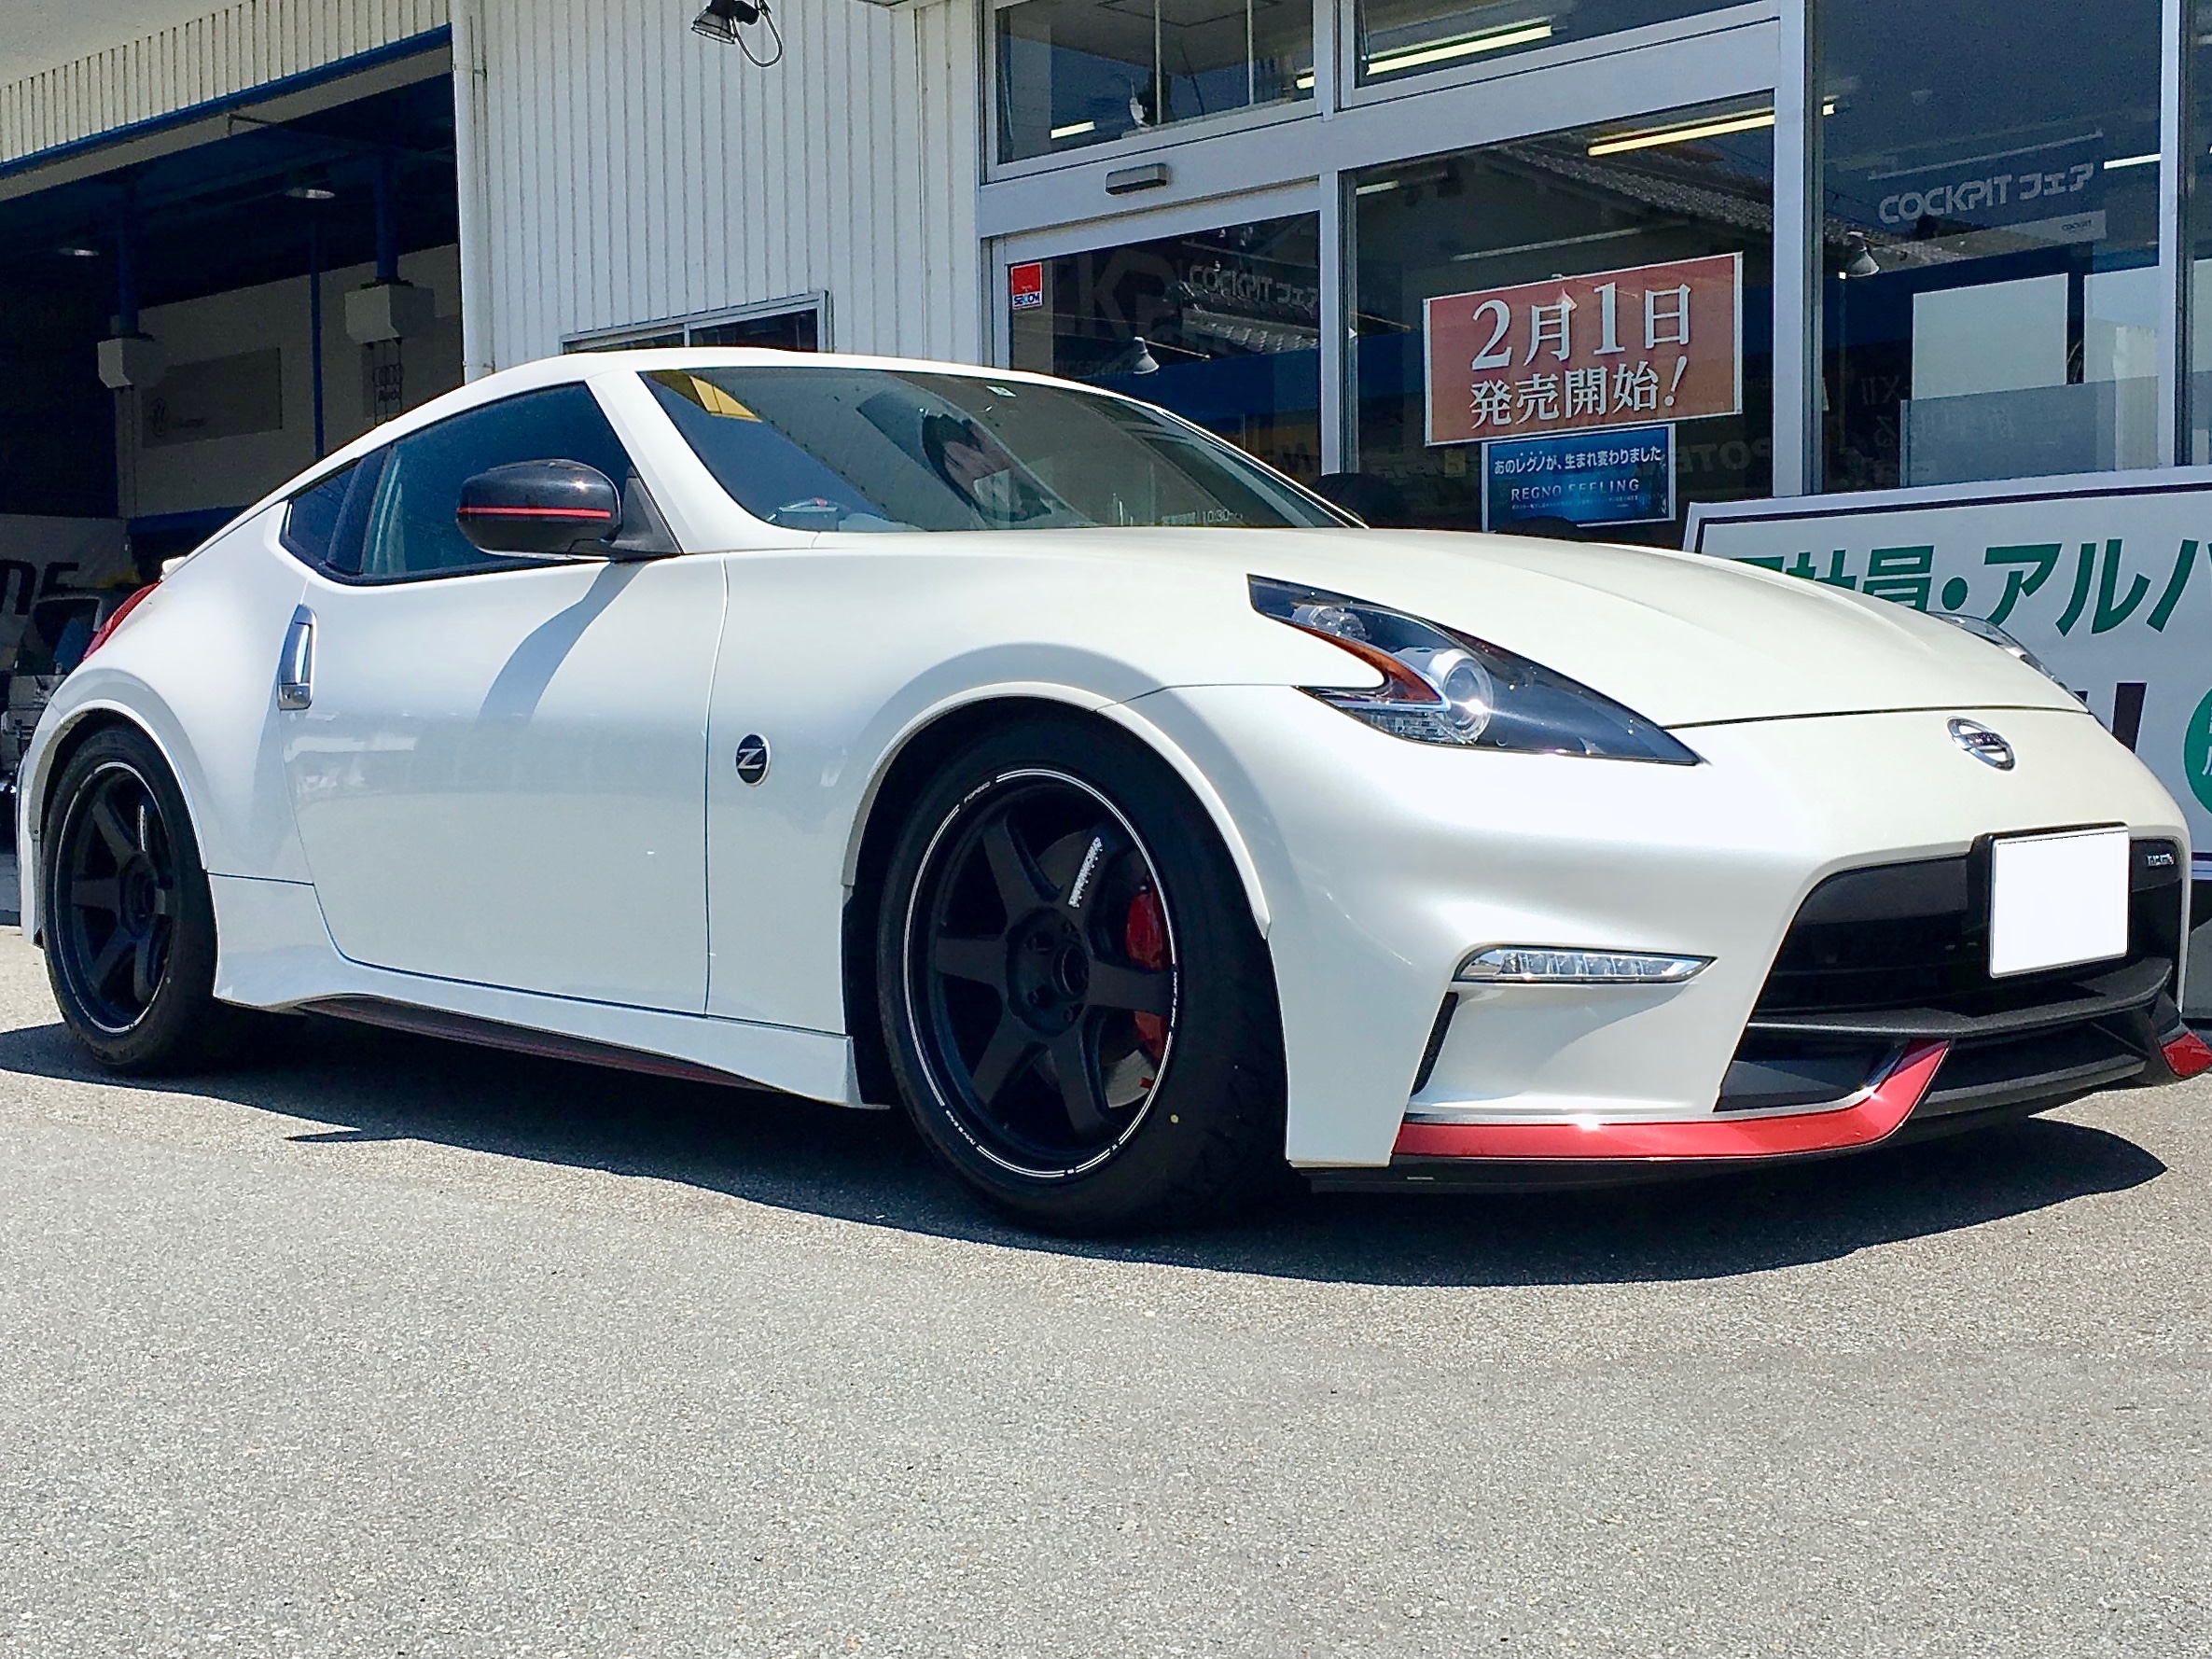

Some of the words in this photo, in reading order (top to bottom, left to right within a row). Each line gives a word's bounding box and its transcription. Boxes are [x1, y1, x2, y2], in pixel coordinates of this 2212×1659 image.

[1879, 174, 2012, 224] COCKPIT
[2018, 162, 2094, 201] フェア
[1470, 282, 1691, 371] 2月1日
[1510, 484, 1562, 502] REGNO
[1730, 538, 2212, 637] 員・アル
[738, 747, 763, 770] Z
